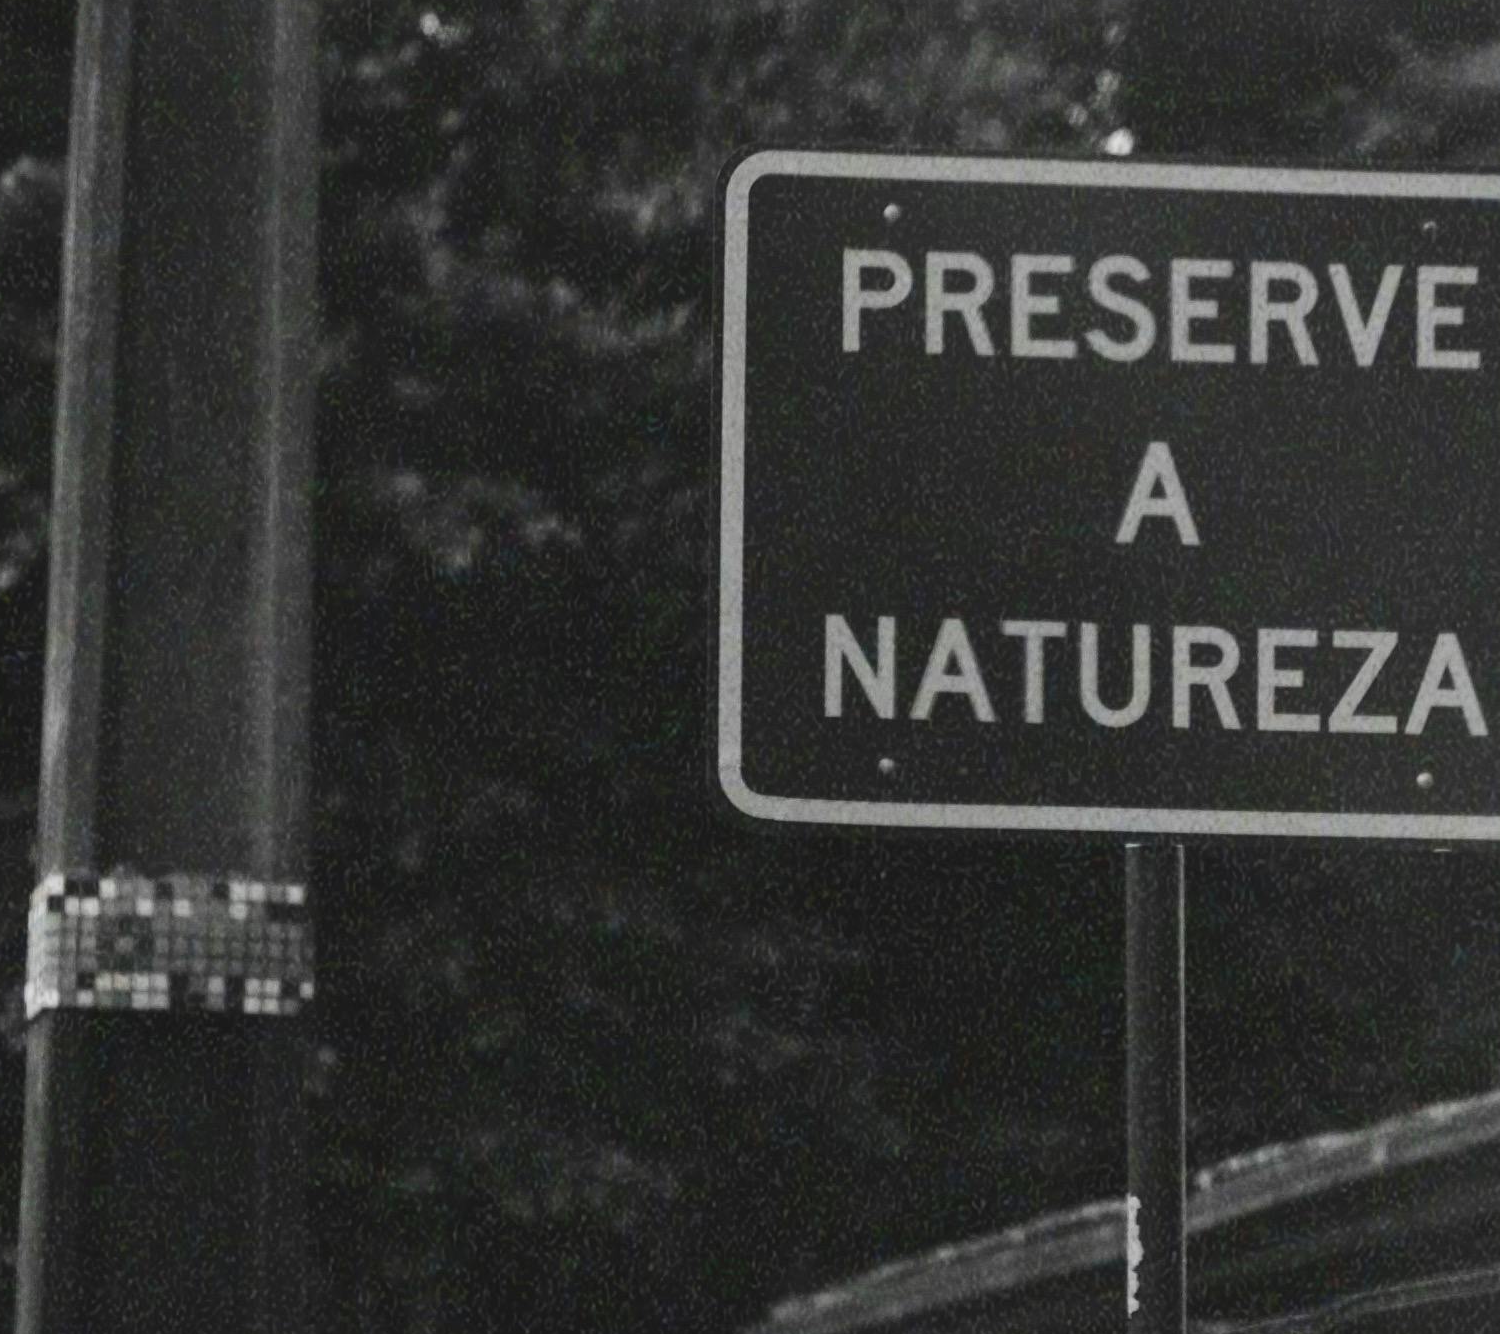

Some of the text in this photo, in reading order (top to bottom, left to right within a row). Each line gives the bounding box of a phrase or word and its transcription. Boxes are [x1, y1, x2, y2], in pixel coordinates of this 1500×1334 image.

[840, 245, 1483, 371] PRESERVE
[1113, 439, 1202, 548] A
[822, 612, 1491, 737] NATUREZA
